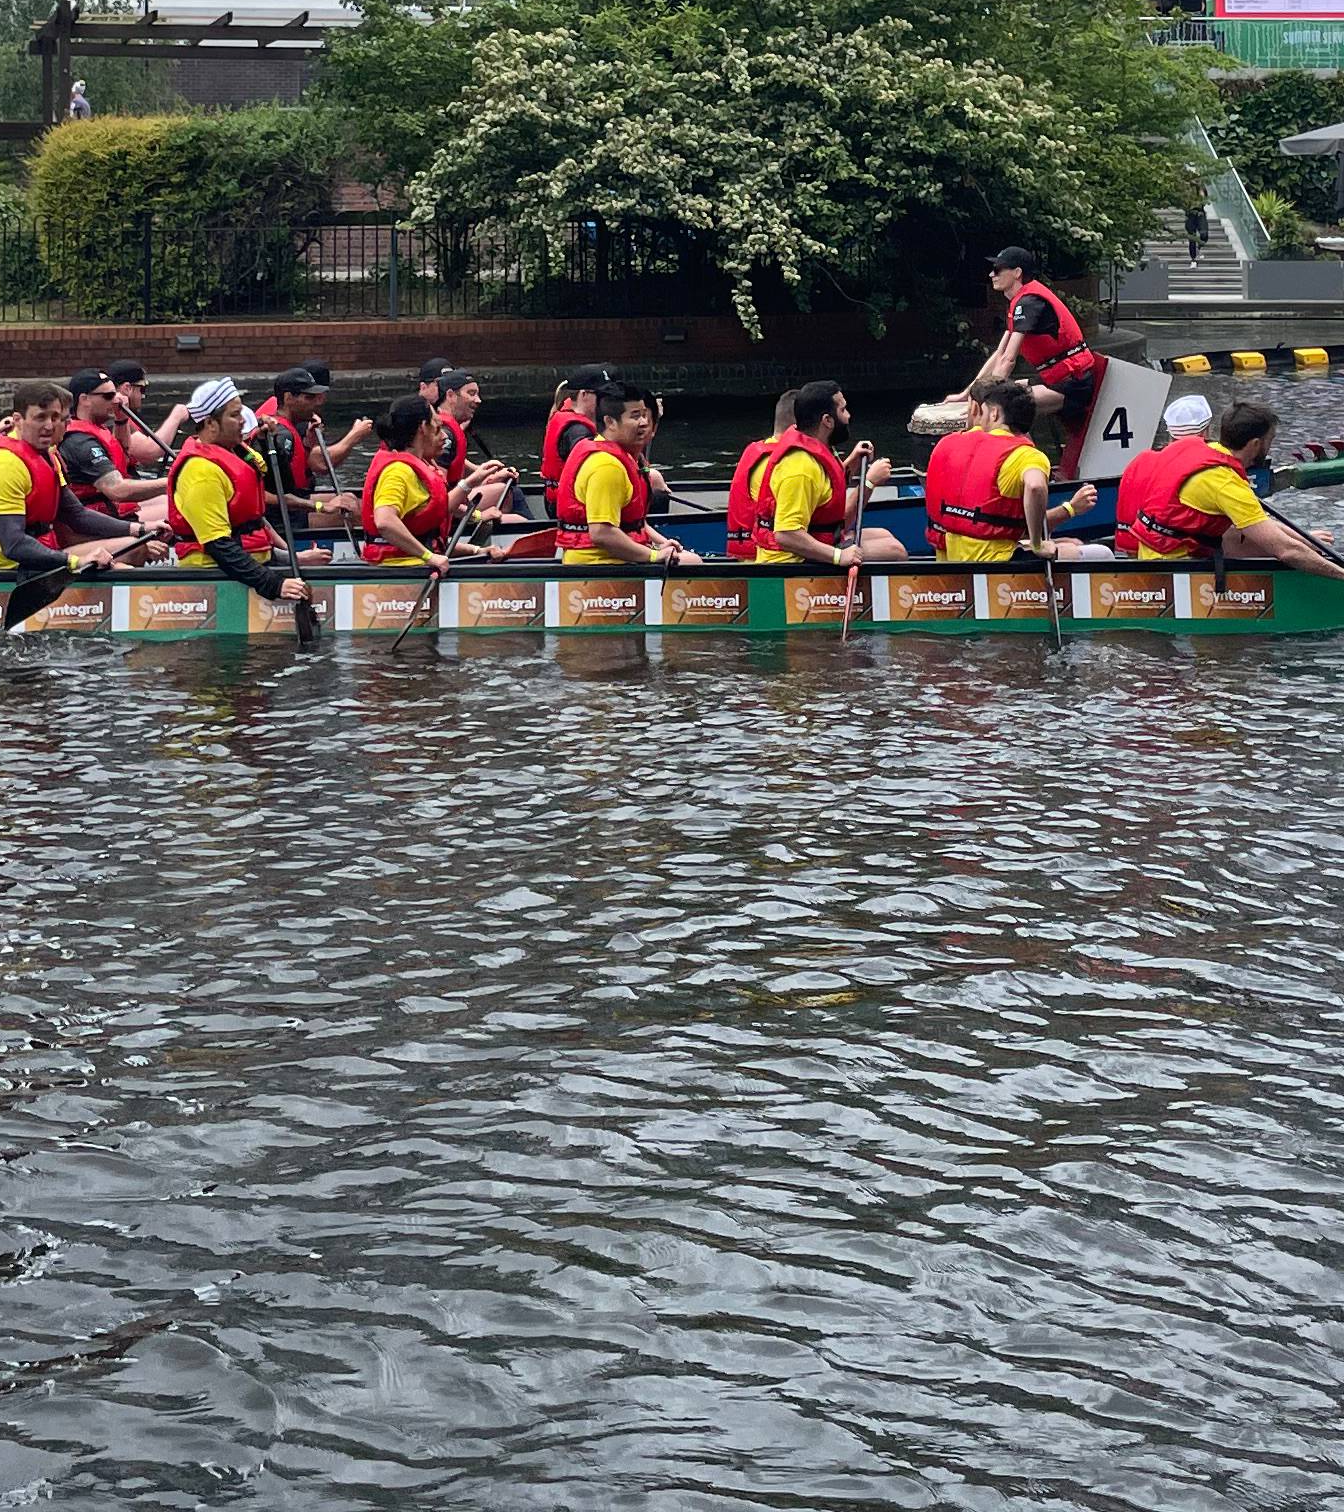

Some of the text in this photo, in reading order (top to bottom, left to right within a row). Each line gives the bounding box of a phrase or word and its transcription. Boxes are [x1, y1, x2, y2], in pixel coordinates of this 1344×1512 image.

[1102, 406, 1134, 449] 4
[138, 594, 208, 619] Syntegral
[468, 591, 536, 616] Syntegral
[568, 590, 636, 614] Syntegral
[671, 588, 739, 613] Syntegral
[898, 586, 966, 610] Syntegral
[1099, 582, 1166, 607] Syntegral
[259, 598, 327, 621] Syntral
